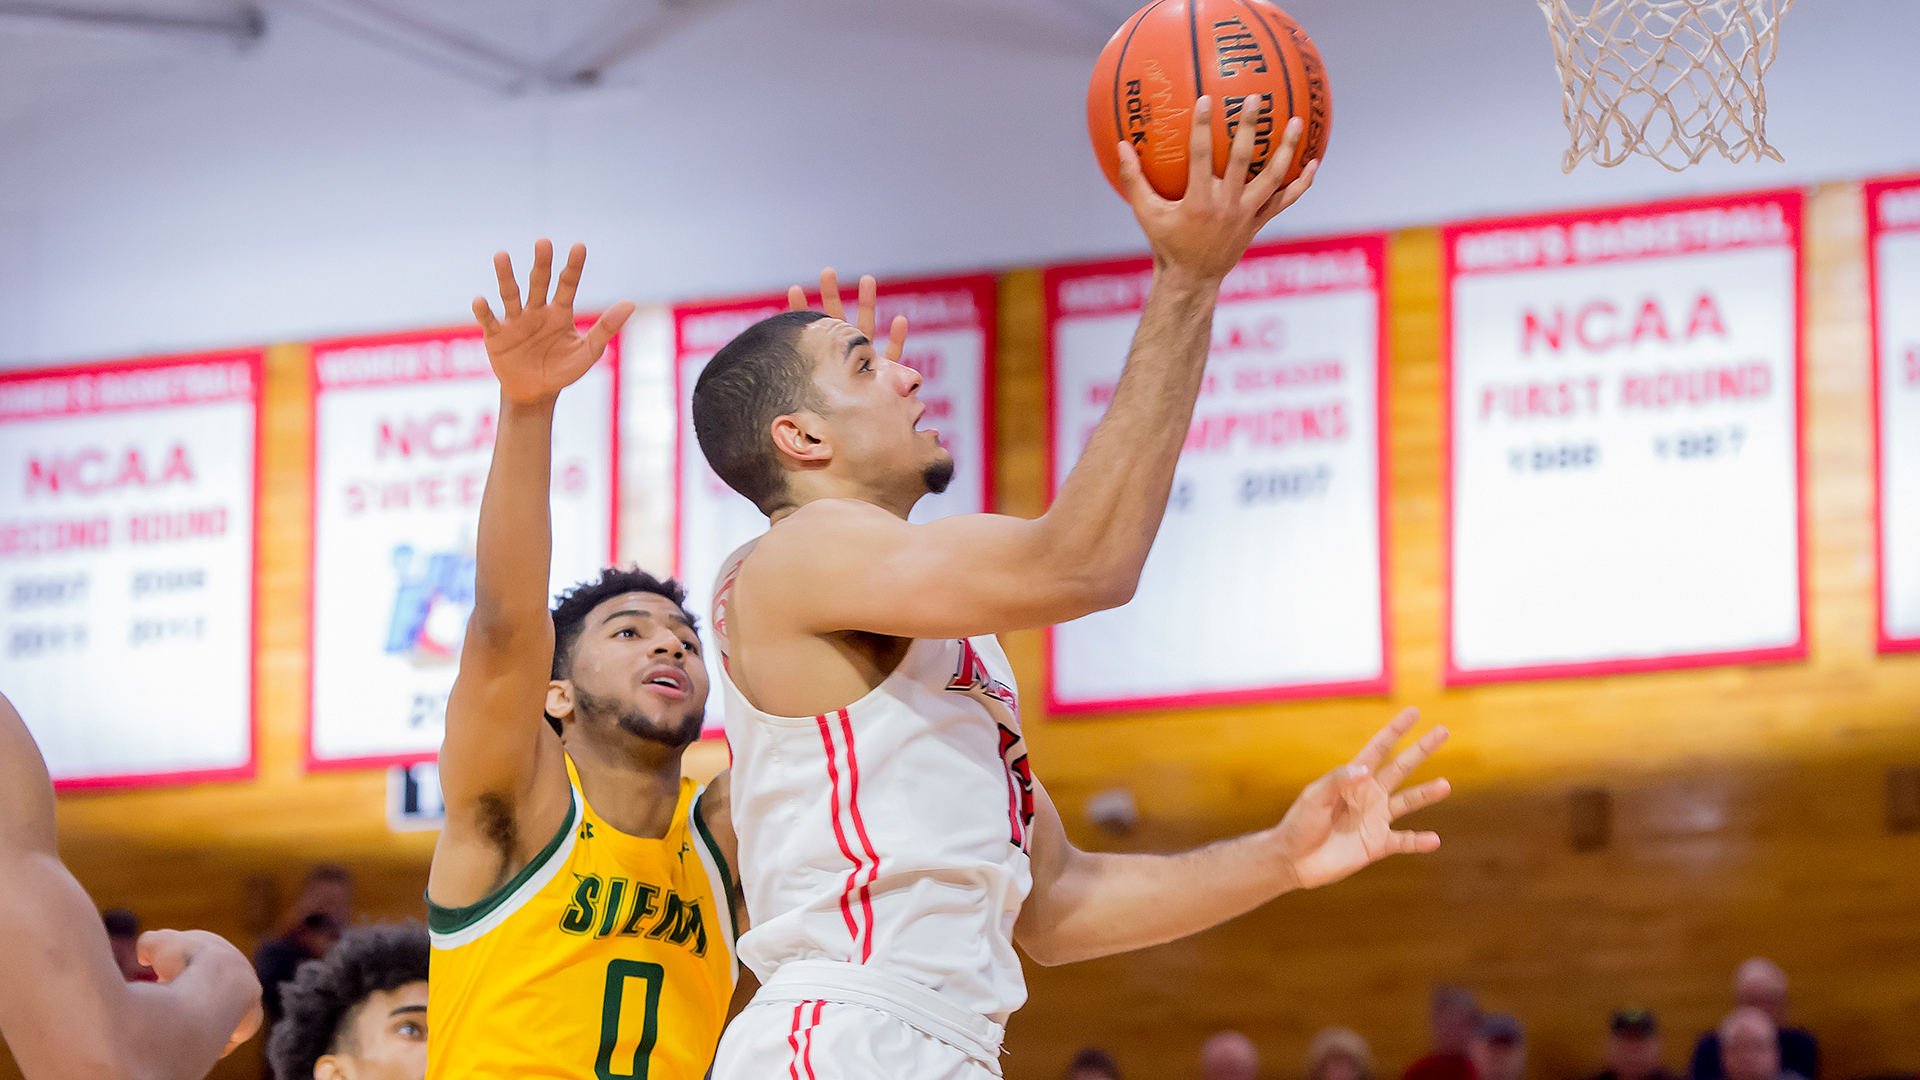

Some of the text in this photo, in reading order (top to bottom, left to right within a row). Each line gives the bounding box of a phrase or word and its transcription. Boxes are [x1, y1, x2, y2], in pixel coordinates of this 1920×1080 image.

[1212, 14, 1269, 79] THE
[1520, 295, 1727, 356] NCAA
[1478, 365, 1772, 420] FIRST ROUND
[24, 444, 196, 500] NCAA
[130, 508, 229, 544] ROUND
[594, 958, 665, 1080] 0
